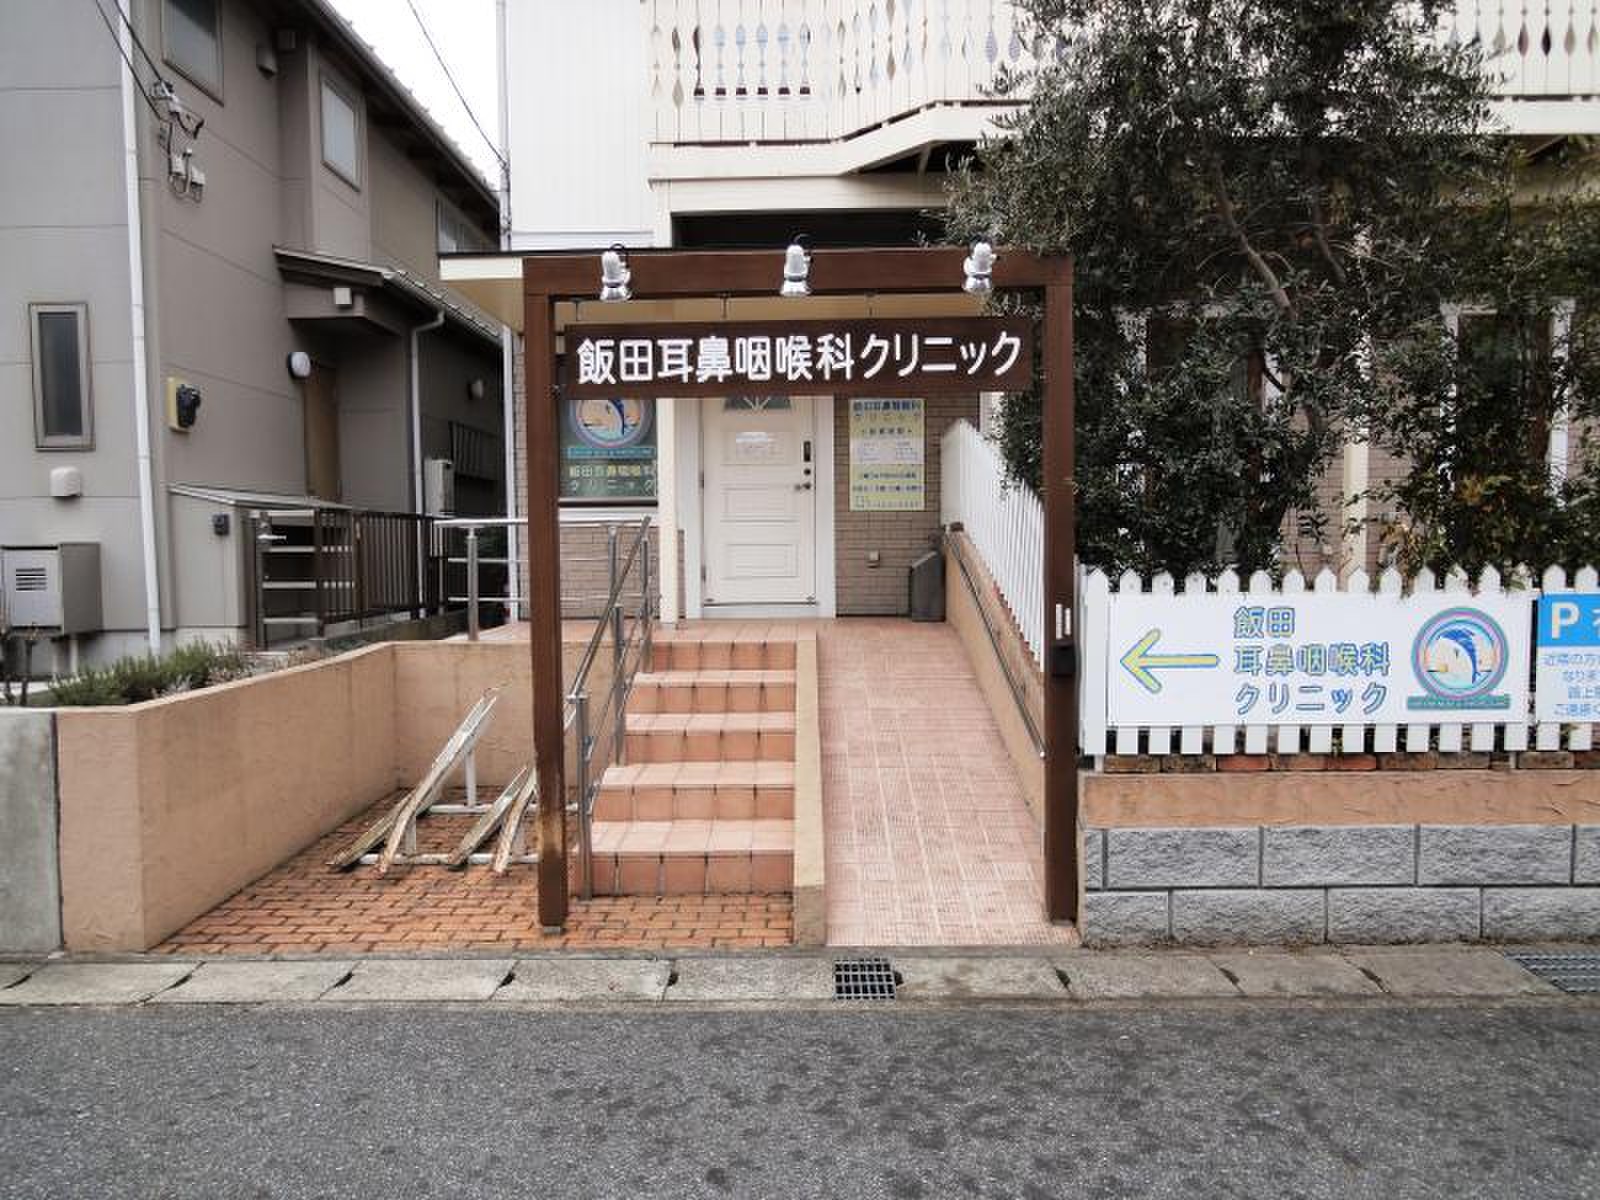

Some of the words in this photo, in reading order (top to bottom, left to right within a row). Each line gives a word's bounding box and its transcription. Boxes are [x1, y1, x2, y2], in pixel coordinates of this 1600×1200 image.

[577, 331, 1022, 385] 飯田耳鼻咽喉科クリニック
[1234, 606, 1296, 638] 飯田
[1551, 602, 1580, 640] P
[1234, 642, 1391, 676] 耳鼻咽喉科
[1236, 682, 1388, 715] クリニック
